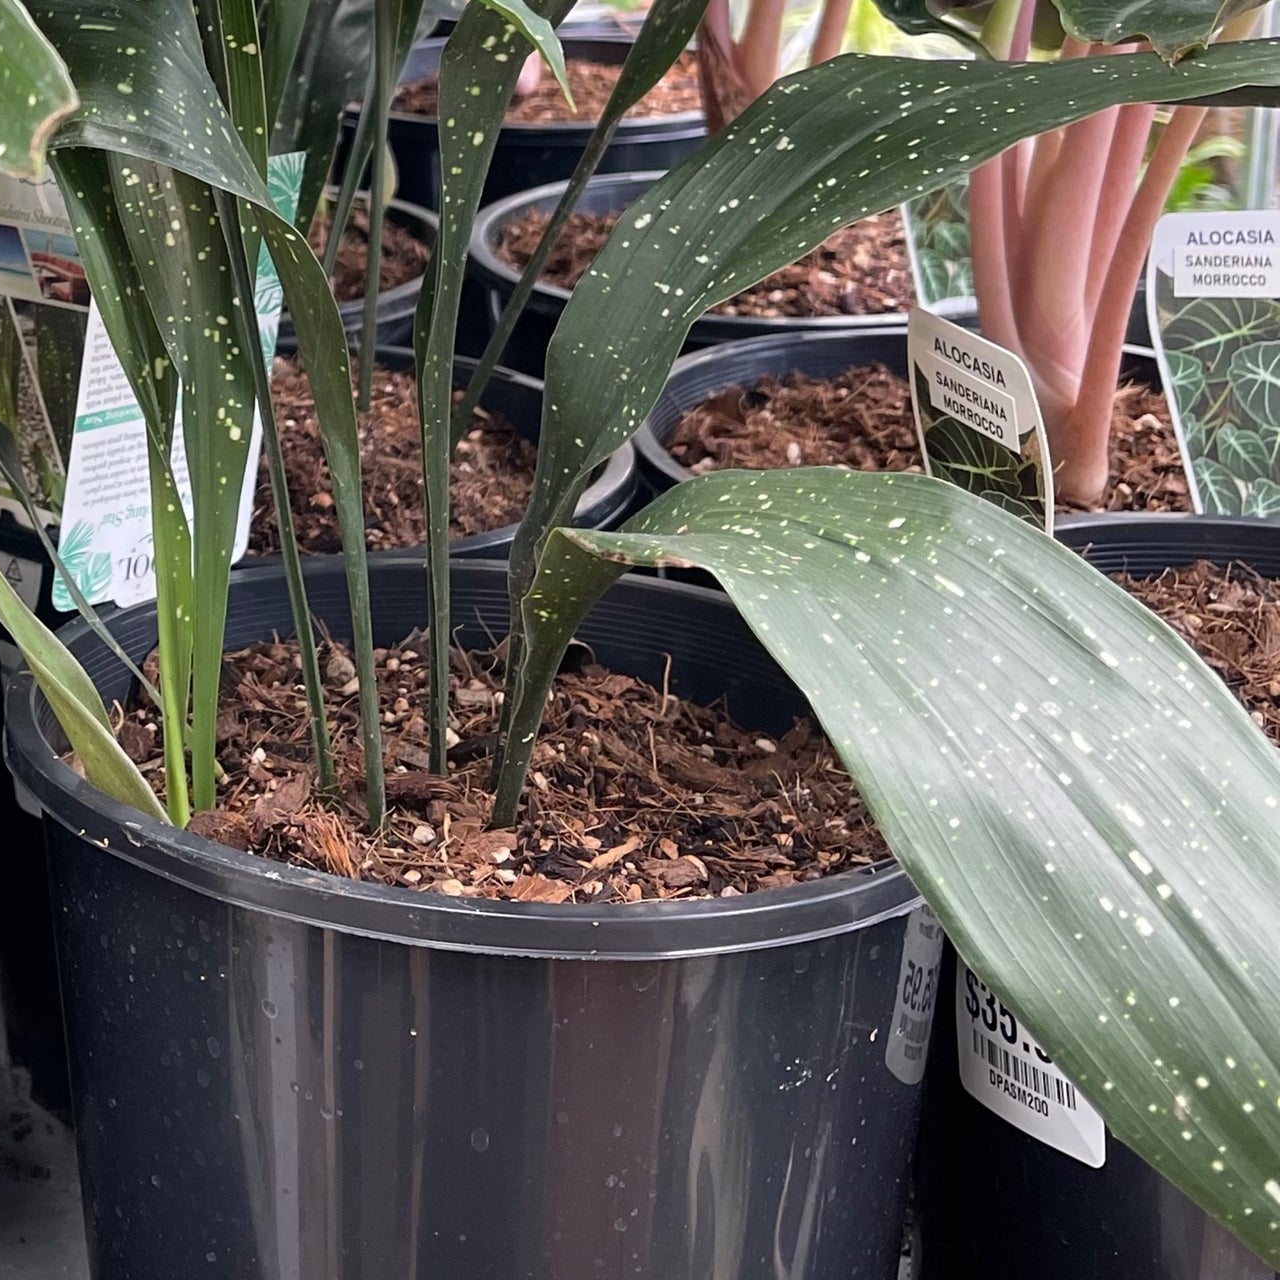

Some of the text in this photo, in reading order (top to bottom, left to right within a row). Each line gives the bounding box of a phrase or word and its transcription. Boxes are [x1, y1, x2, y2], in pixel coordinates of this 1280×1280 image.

[1186, 230, 1275, 246] ALOCASIA
[1185, 255, 1272, 268] SANDERIANA
[1192, 274, 1266, 287] MORROCCO
[934, 337, 1006, 388] ALOCASIA
[935, 371, 1007, 422] SANDERIANA
[943, 394, 1004, 439] MORROCCO
[964, 967, 1053, 1064] $35.
[989, 1069, 1049, 1117] DPASM200
